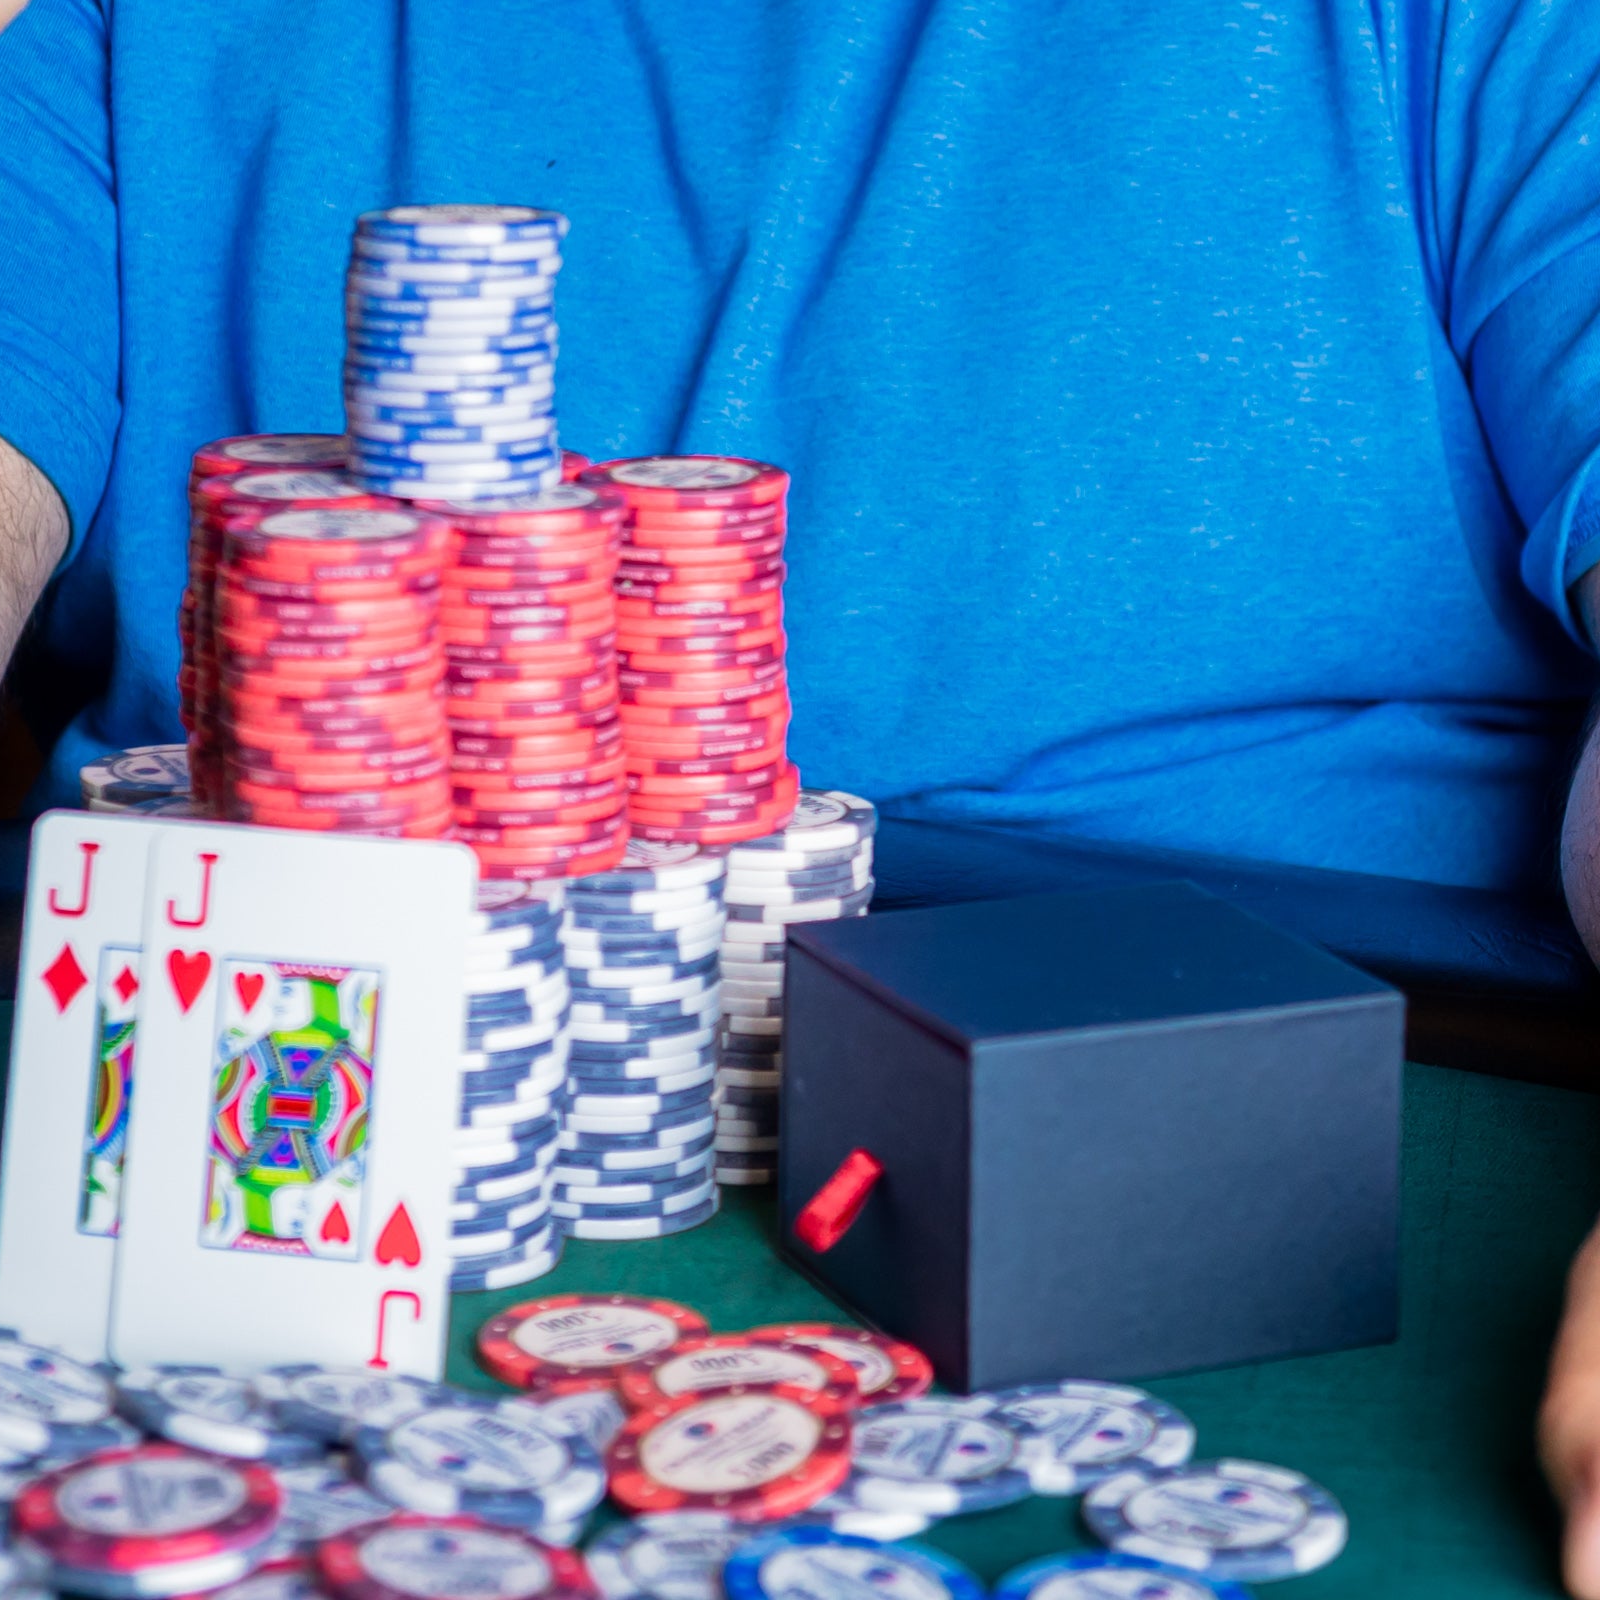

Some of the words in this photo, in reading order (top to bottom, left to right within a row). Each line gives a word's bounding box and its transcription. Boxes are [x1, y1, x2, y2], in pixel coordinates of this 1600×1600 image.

[48, 842, 100, 918] J
[166, 853, 219, 928] J
[366, 1289, 422, 1369] J
